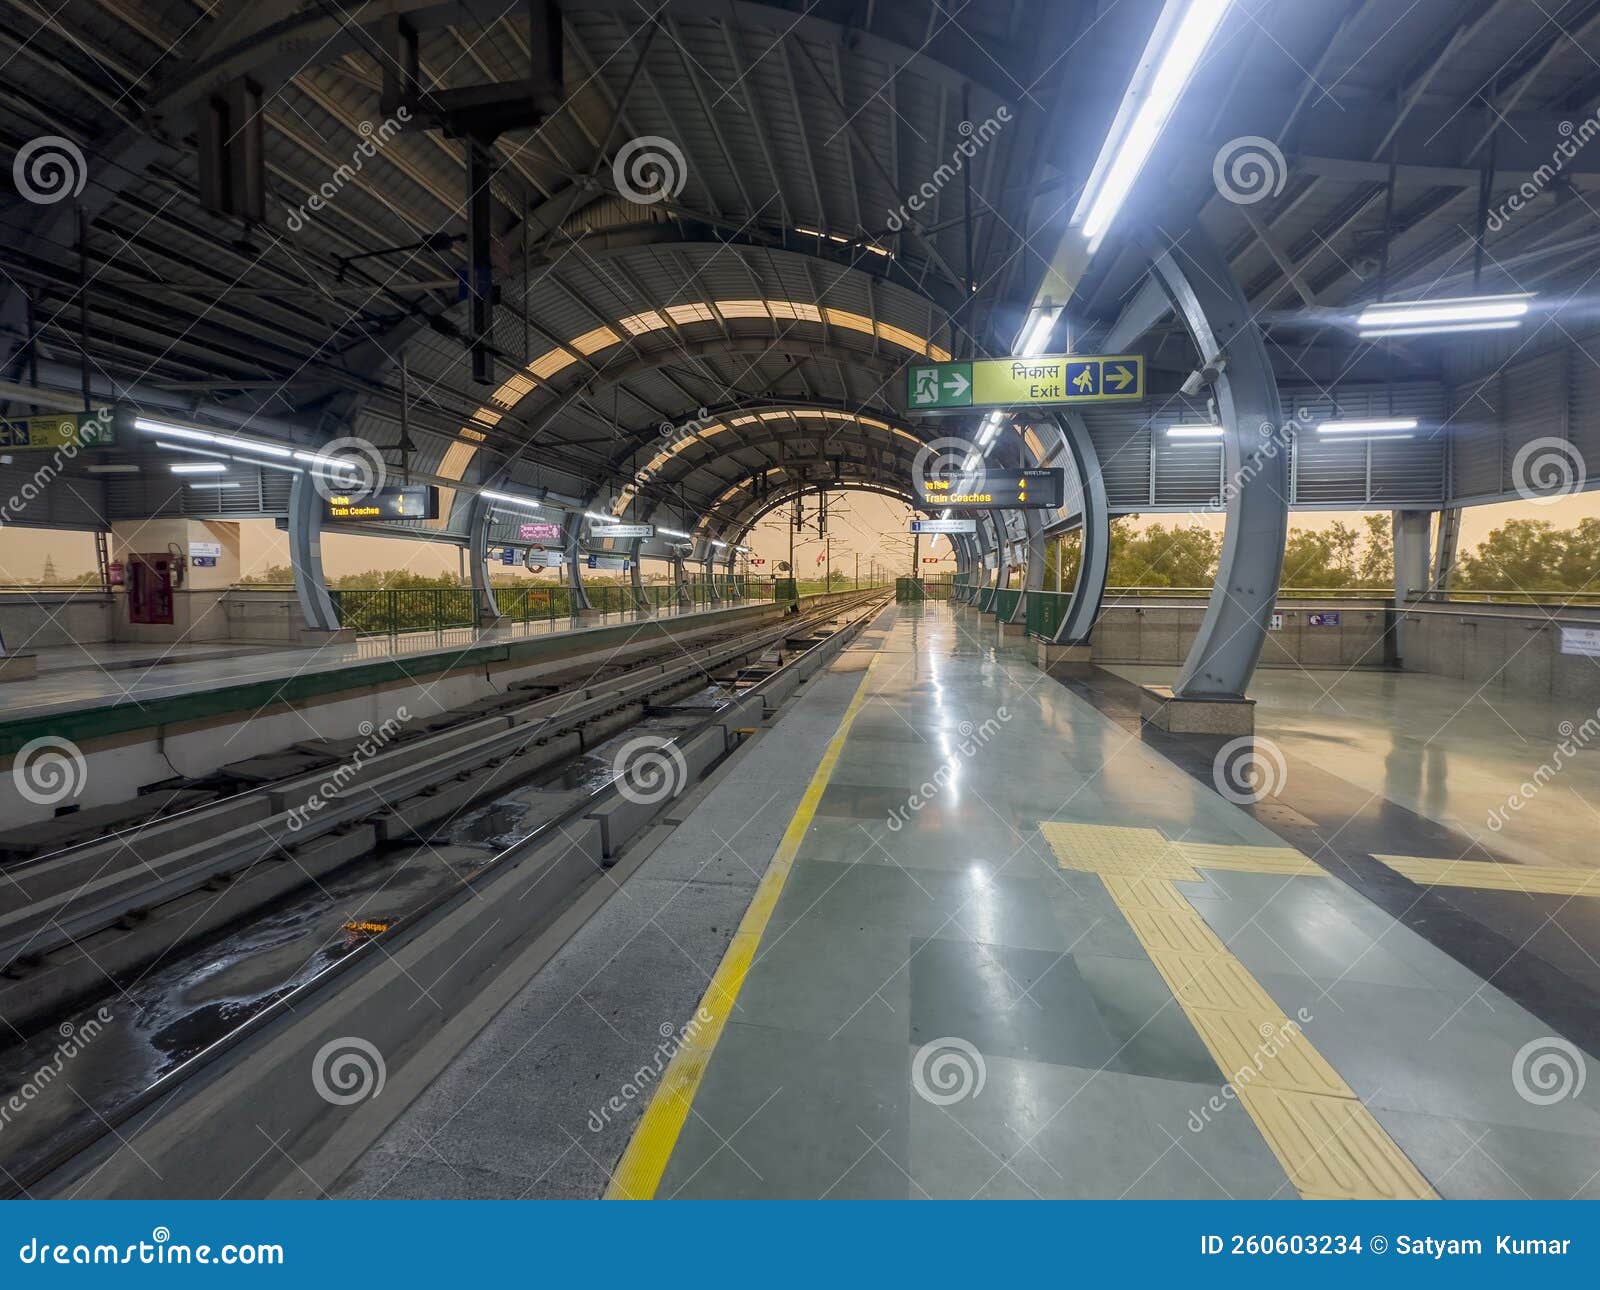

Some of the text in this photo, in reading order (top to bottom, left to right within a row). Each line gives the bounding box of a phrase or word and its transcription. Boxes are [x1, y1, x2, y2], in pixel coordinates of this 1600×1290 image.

[1011, 362, 1060, 380] निकास
[1030, 385, 1060, 398] Exit
[1018, 479, 1027, 488] 4
[924, 492, 1027, 503] Train Coaches 4
[331, 507, 349, 516] Train
[350, 507, 380, 515] Coaches
